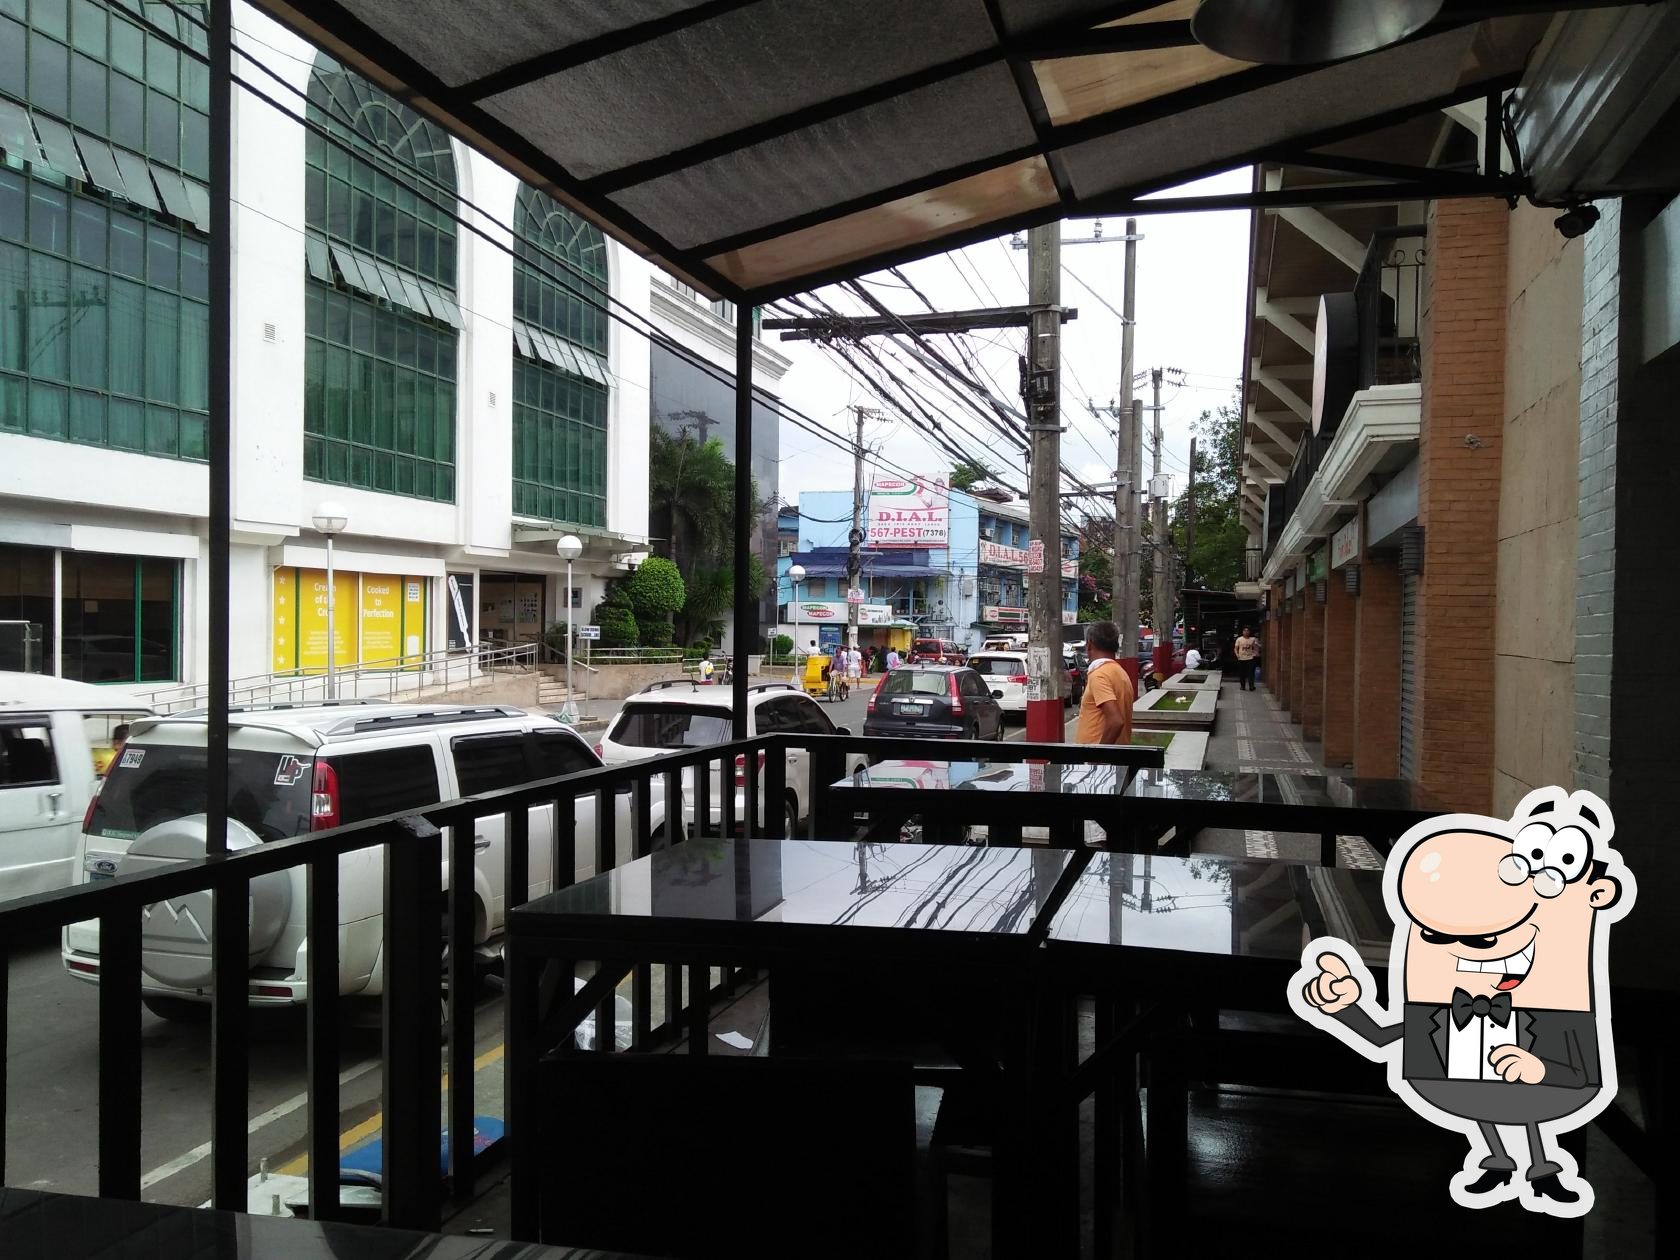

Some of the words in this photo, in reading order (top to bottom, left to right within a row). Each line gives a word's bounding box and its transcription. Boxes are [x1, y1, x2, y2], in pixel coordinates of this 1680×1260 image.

[878, 511, 943, 522] D.I.A.L.
[366, 585, 390, 594] Cooked
[315, 594, 323, 604] of
[375, 597, 382, 606] to
[363, 608, 394, 618] Perfection
